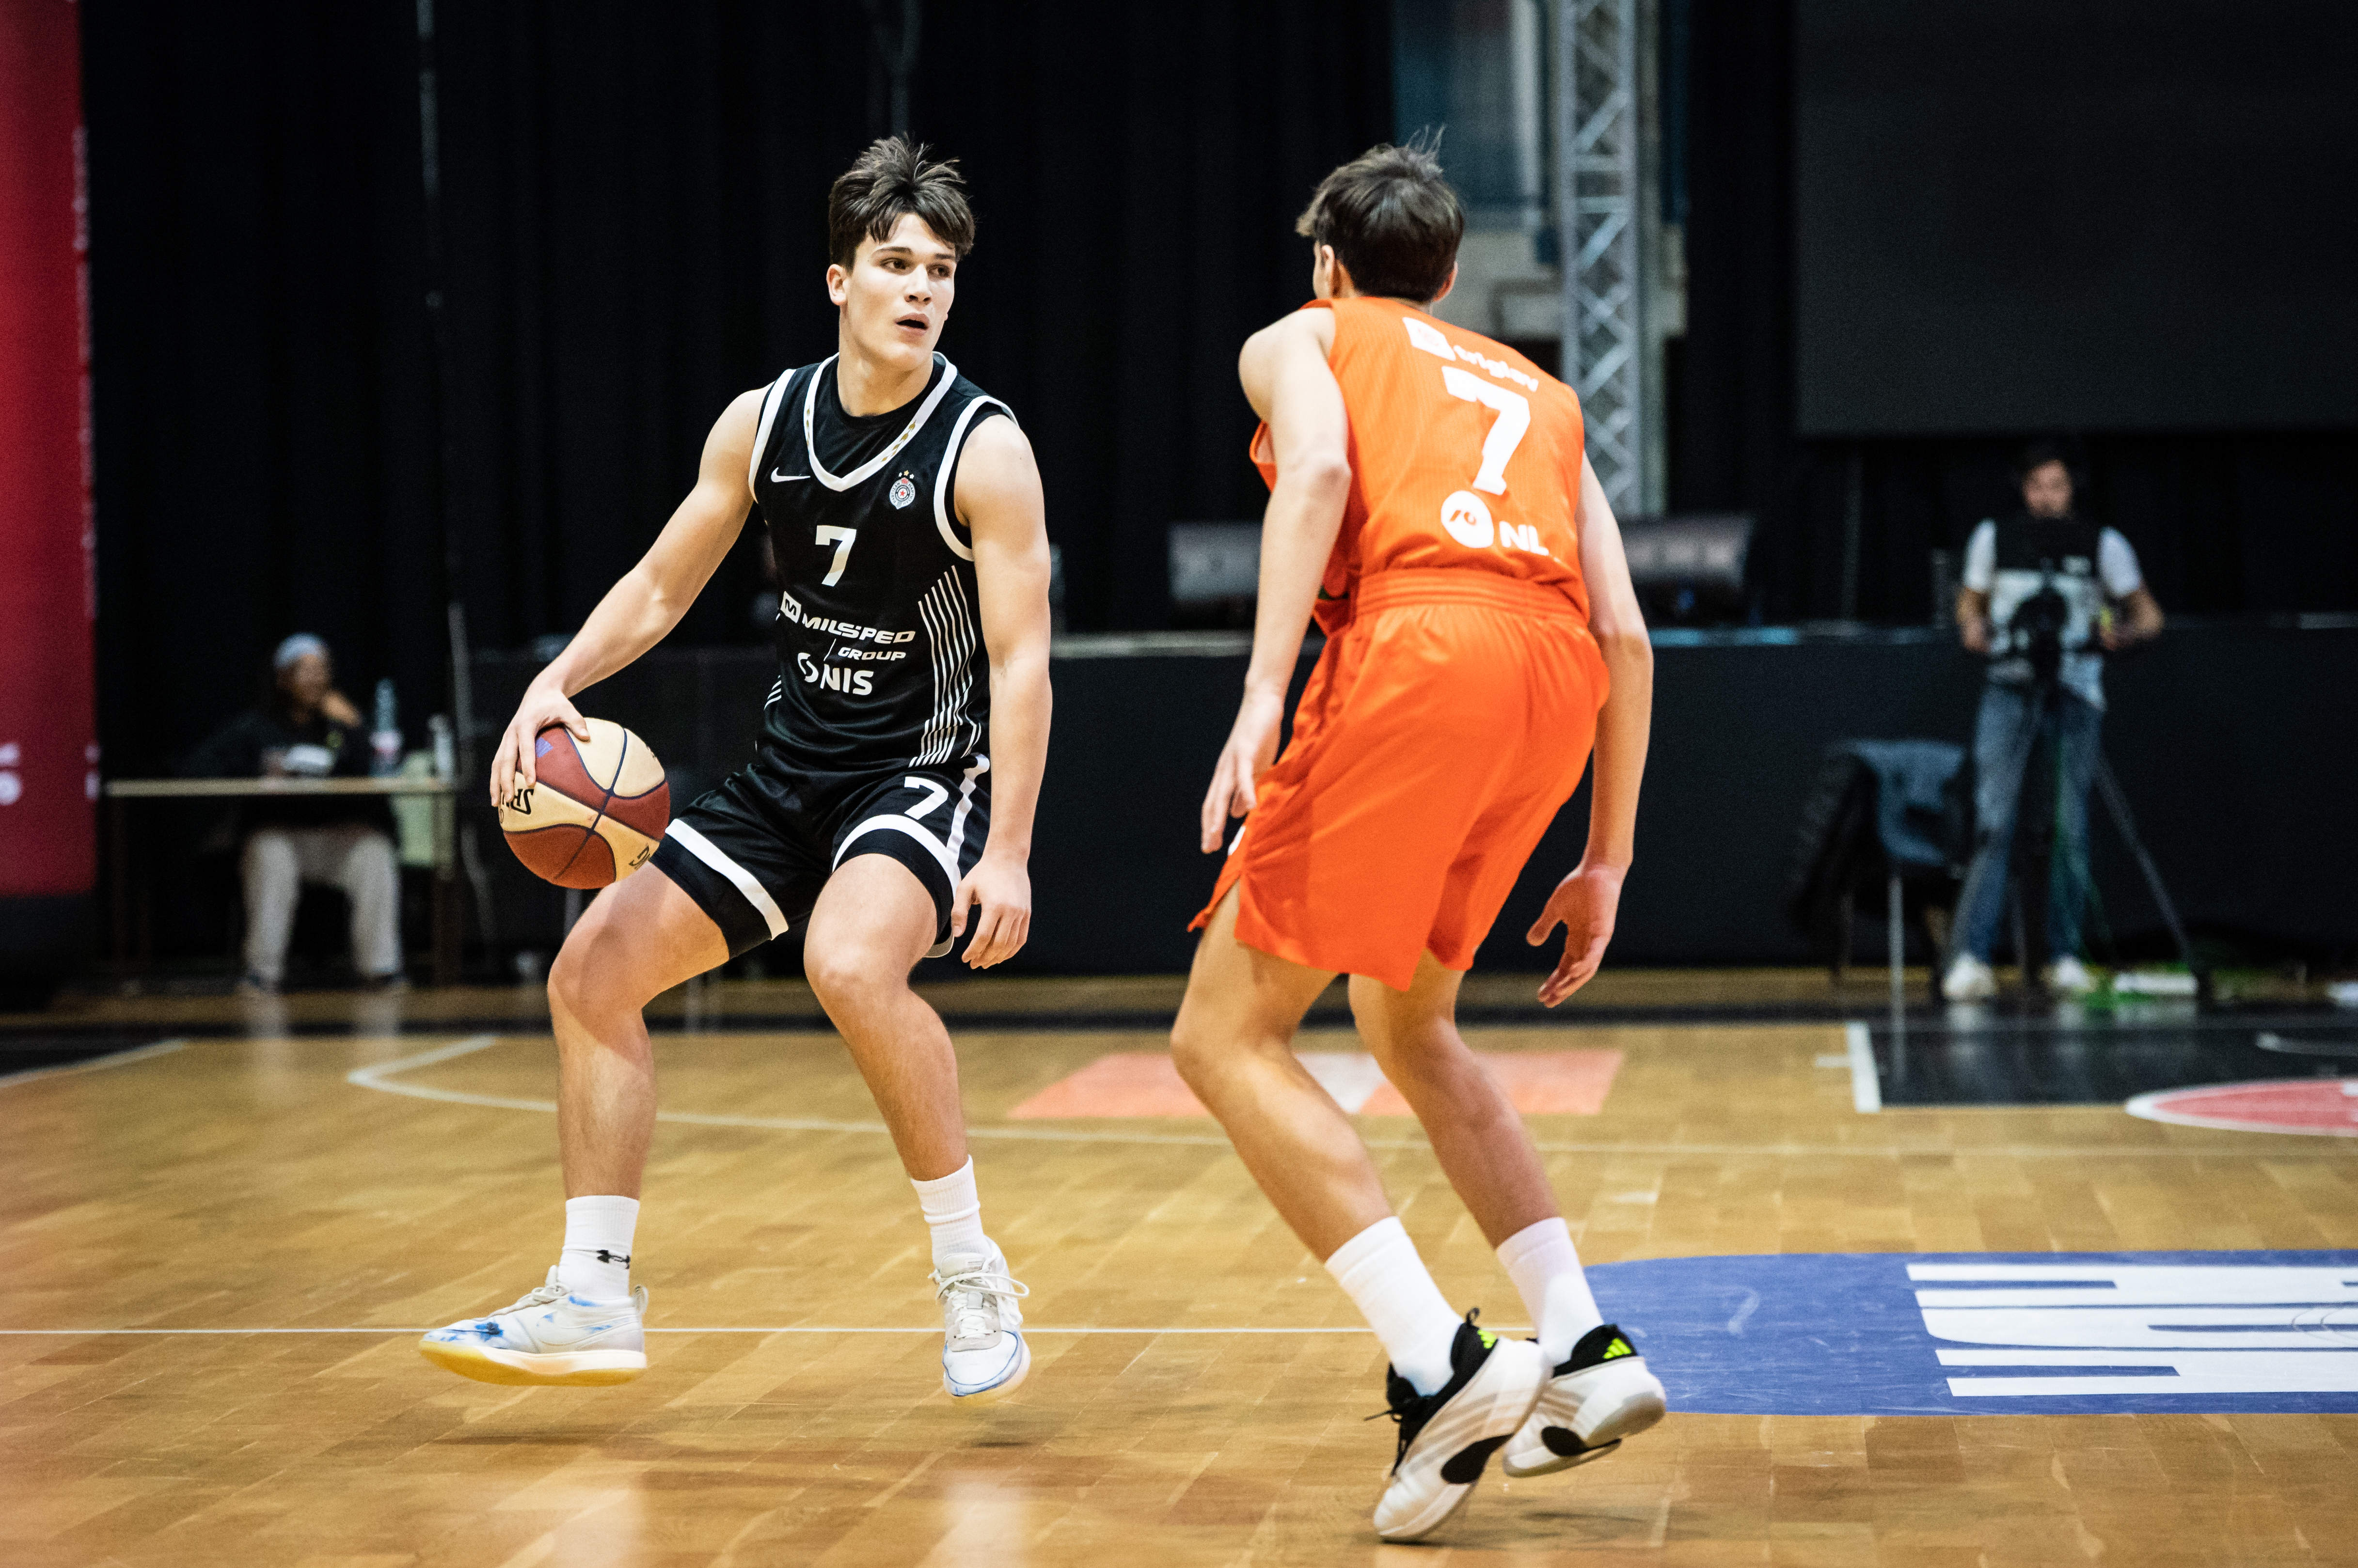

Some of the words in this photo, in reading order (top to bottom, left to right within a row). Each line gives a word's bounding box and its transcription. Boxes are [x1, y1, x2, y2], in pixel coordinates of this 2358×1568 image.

[1441, 366, 1531, 495] 7
[815, 525, 856, 587] 7
[1499, 520, 1560, 562] NL
[838, 647, 906, 661] GROUP
[820, 664, 874, 695] NIS
[904, 776, 949, 820] 7
